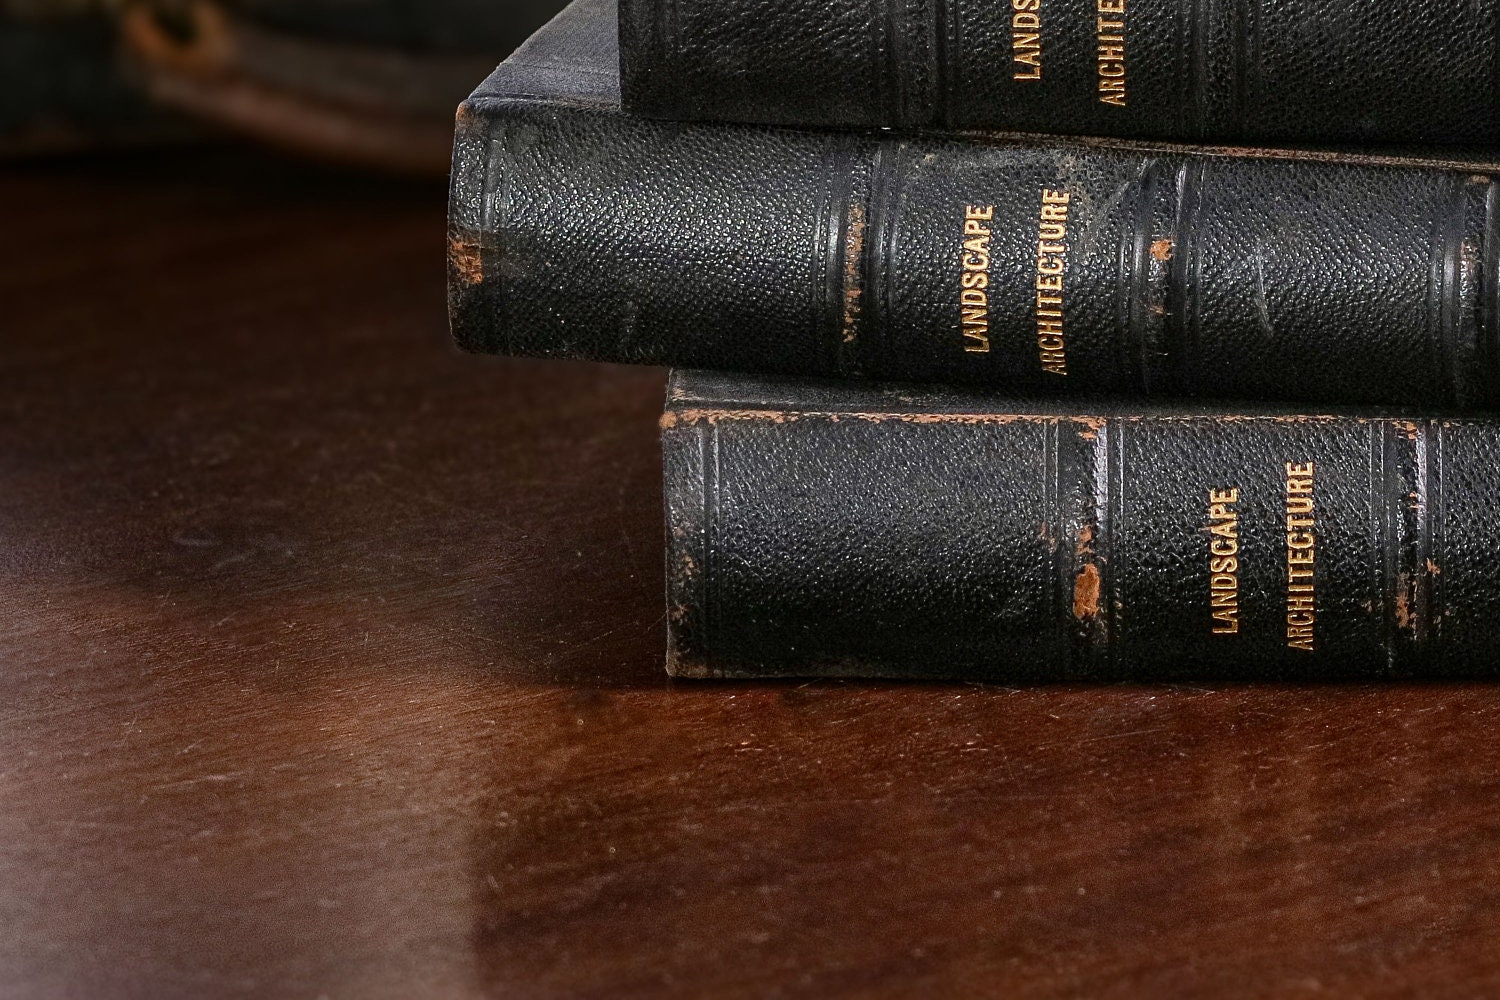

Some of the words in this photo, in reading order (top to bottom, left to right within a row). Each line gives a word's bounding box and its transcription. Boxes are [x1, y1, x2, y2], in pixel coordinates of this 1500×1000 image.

[961, 205, 994, 352] LANDSCAPE
[1035, 189, 1069, 373] ARCHITECTURE
[1209, 487, 1239, 633] LANDSCAPE
[1287, 461, 1316, 651] ARCHITECTURE
